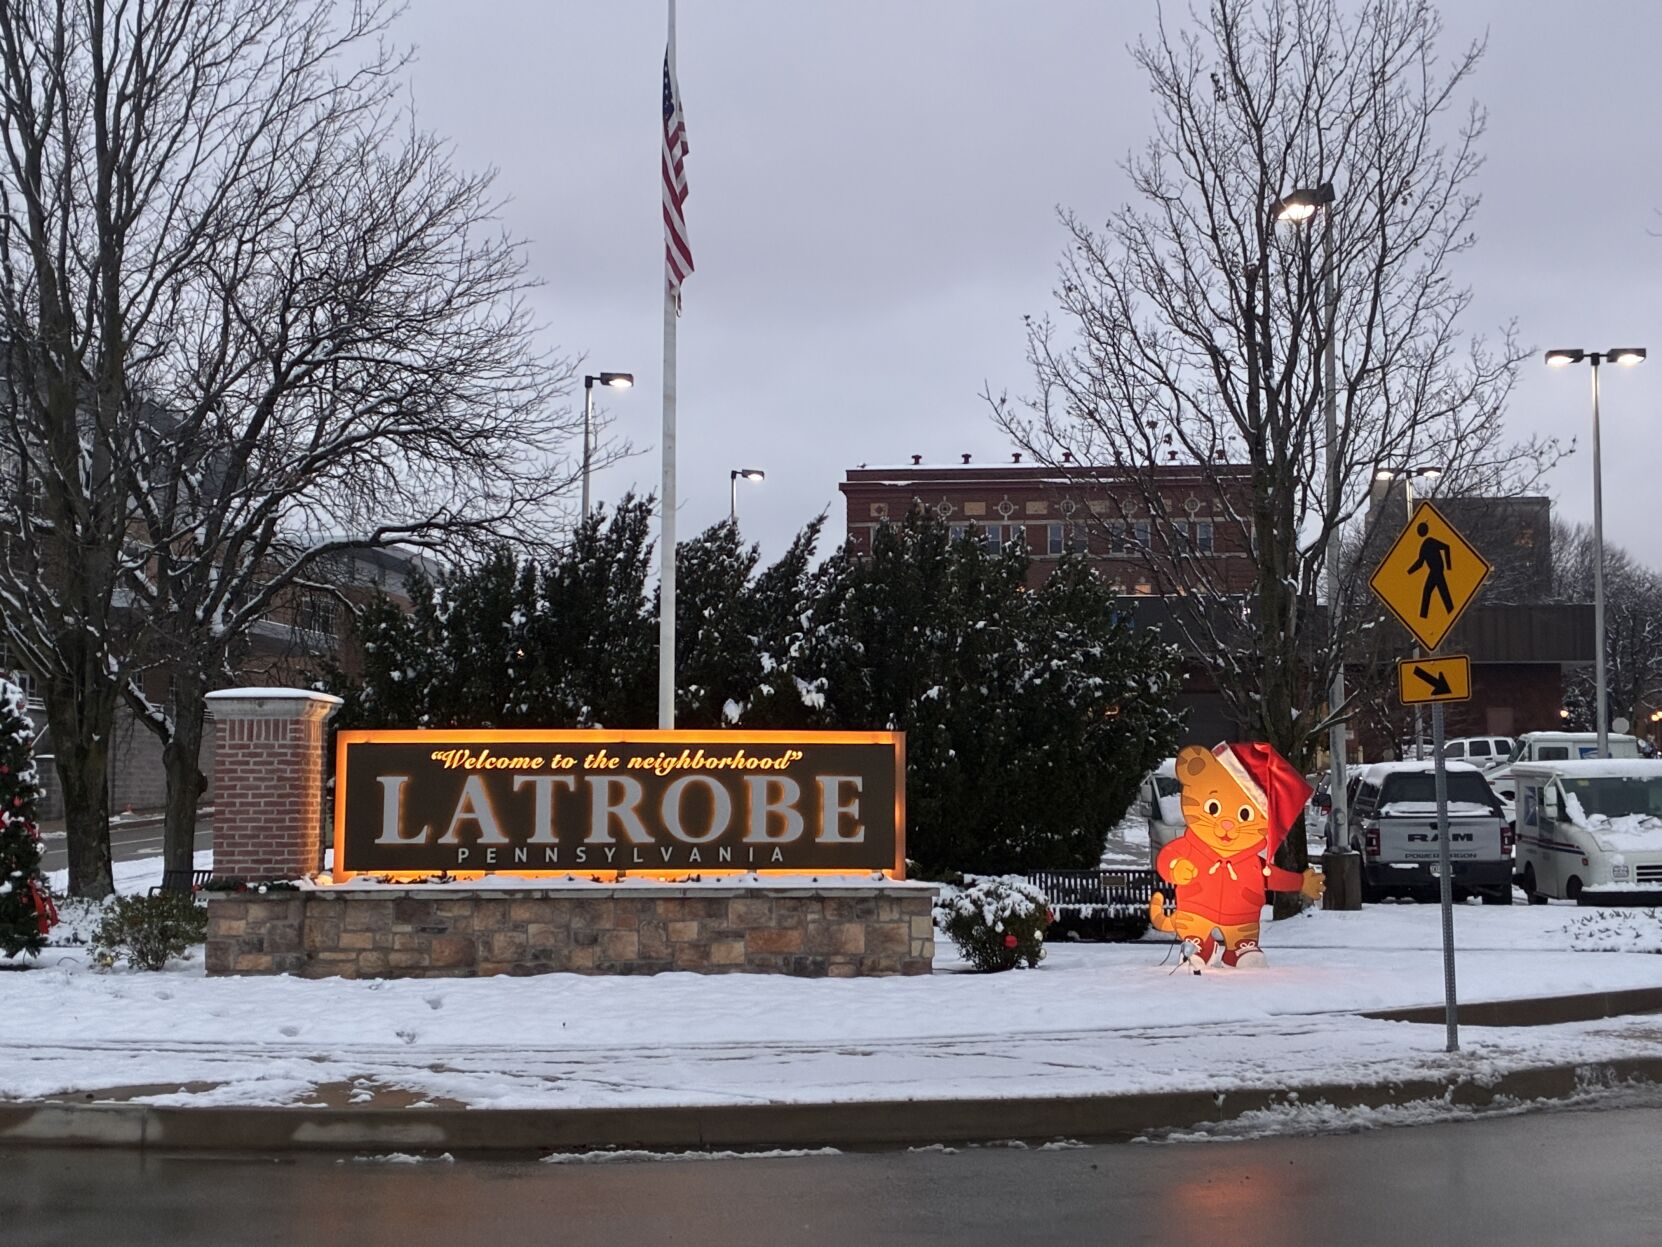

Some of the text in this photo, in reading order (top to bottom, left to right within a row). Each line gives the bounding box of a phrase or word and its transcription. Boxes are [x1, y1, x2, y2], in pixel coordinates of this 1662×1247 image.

[551, 754, 577, 770] to
[583, 749, 620, 770] the
[374, 774, 866, 844] LATROBE
[457, 847, 784, 864] PENNSYLVANIA
